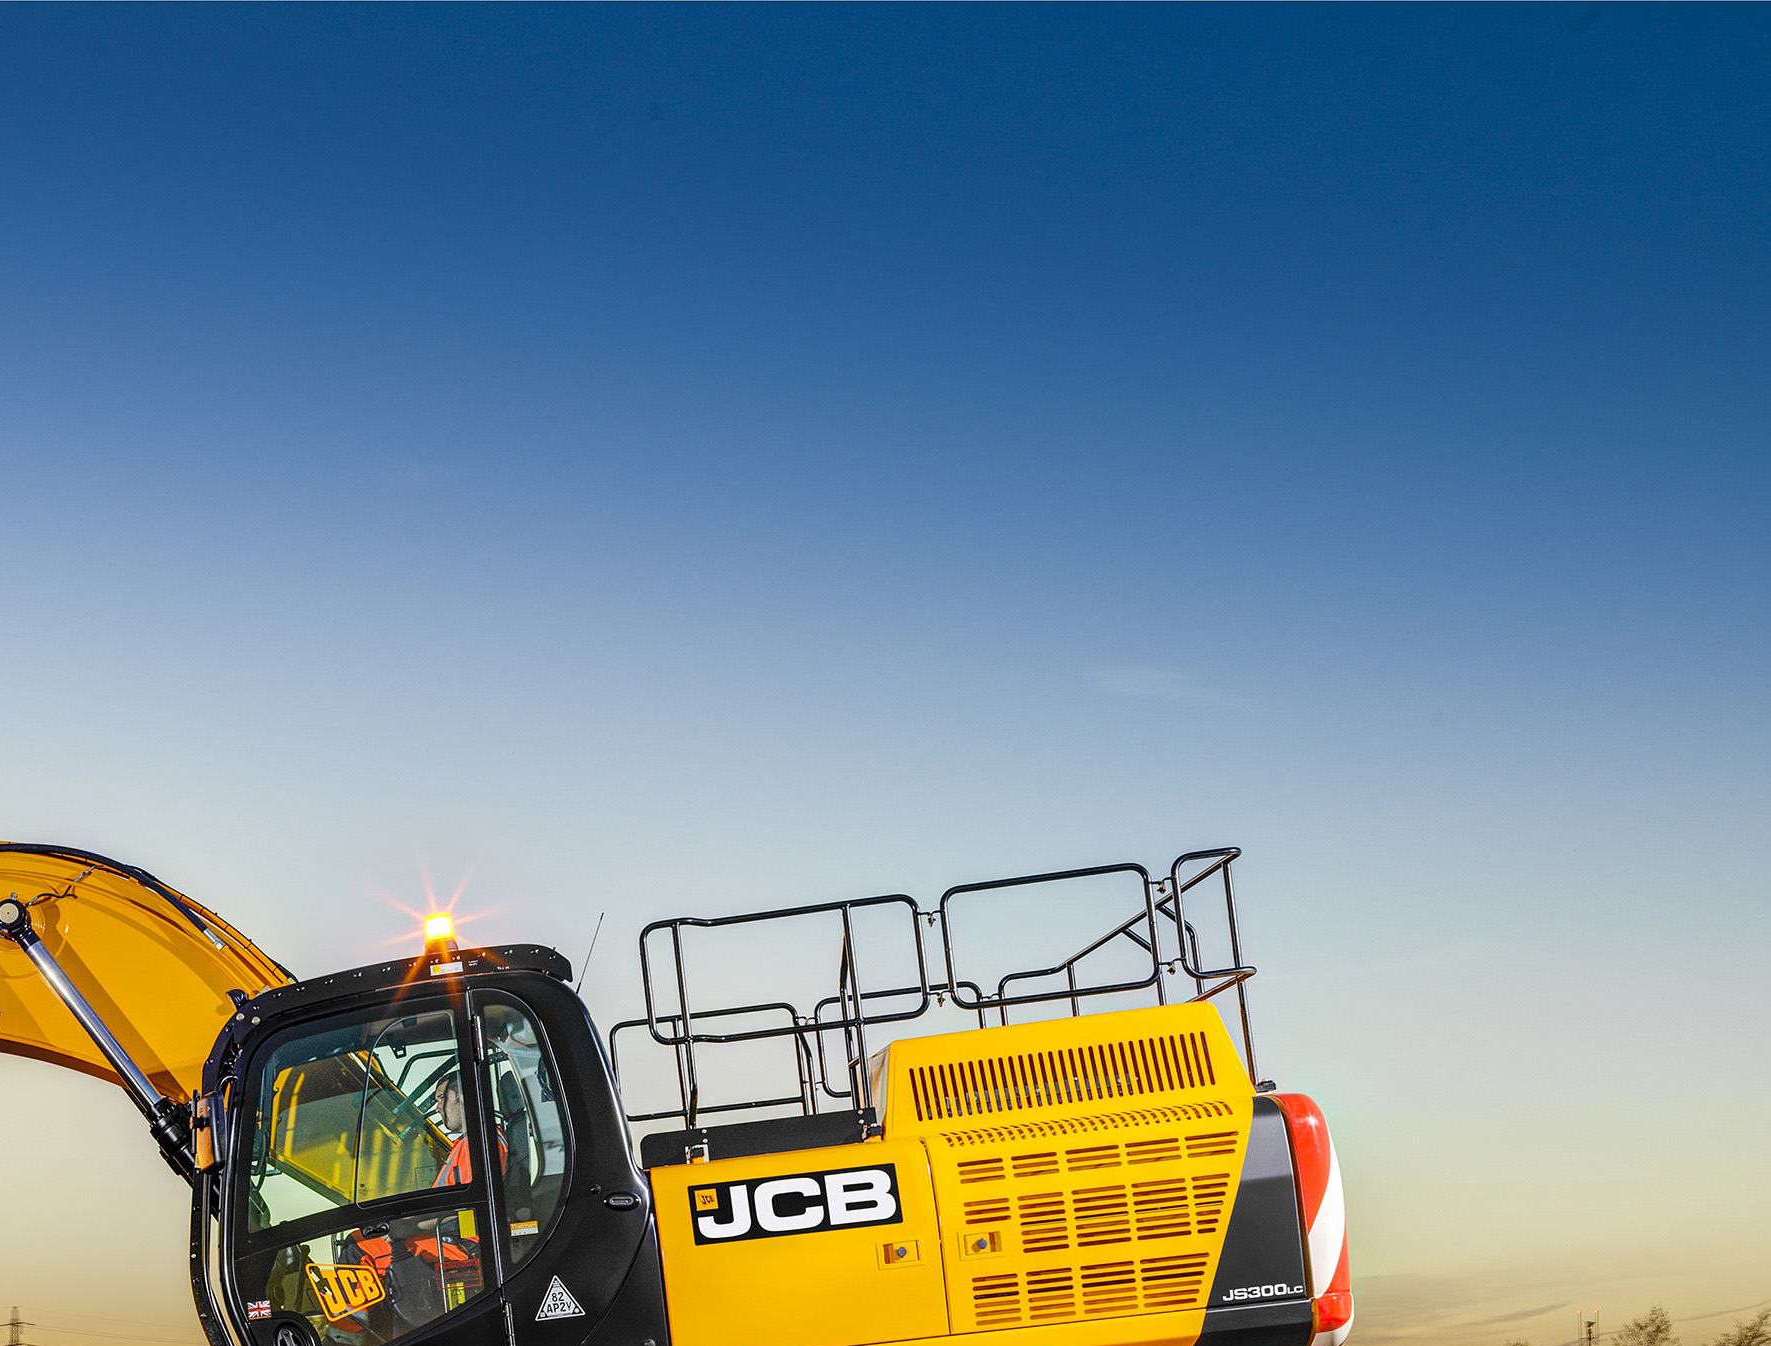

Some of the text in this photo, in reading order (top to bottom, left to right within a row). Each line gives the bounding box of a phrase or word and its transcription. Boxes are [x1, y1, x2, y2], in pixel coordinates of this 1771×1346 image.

[697, 1169, 897, 1239] JCB
[319, 1269, 380, 1314] JCB
[551, 1292, 564, 1302] 82
[1222, 1283, 1304, 1302] JS300LC
[547, 1301, 572, 1313] AP2Y
